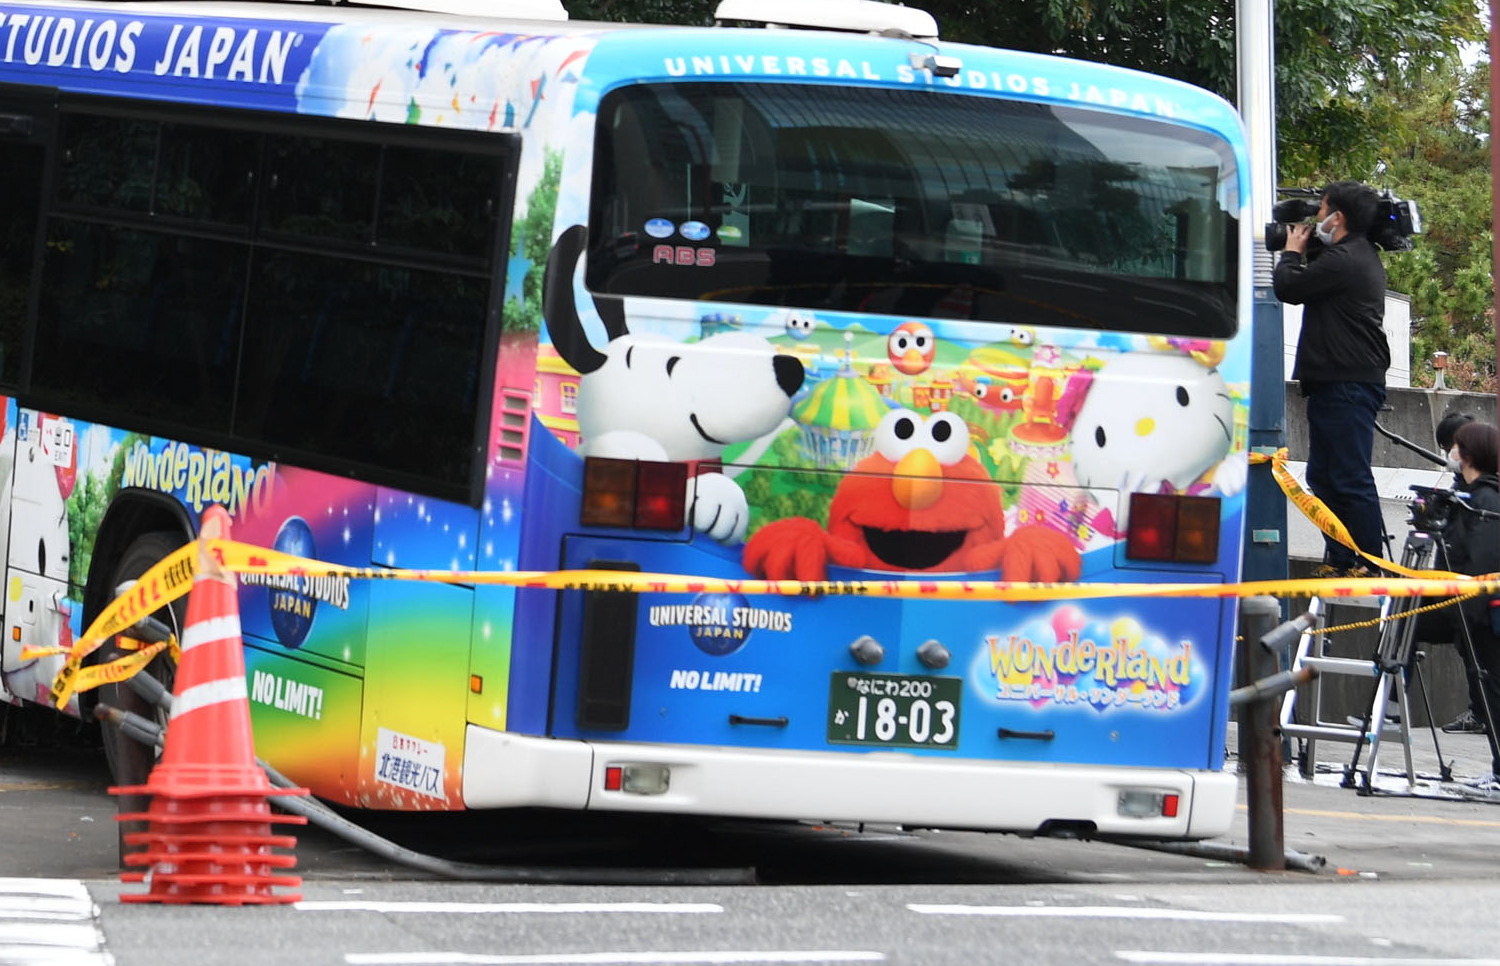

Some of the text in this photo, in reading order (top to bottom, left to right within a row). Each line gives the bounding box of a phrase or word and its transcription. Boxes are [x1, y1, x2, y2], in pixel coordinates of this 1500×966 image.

[154, 24, 298, 85] JAPAN
[663, 55, 881, 82] UNIVERSAL
[1067, 82, 1175, 118] JAPAN
[652, 244, 716, 267] ABS
[273, 593, 312, 619] JAPAN
[649, 604, 792, 633] UNIVERSAL STUDIOS
[695, 626, 744, 640] JAPAN
[251, 669, 324, 721] NO LIMIT!
[670, 669, 763, 693] NO LIMIT!
[856, 696, 956, 744] 18-03
